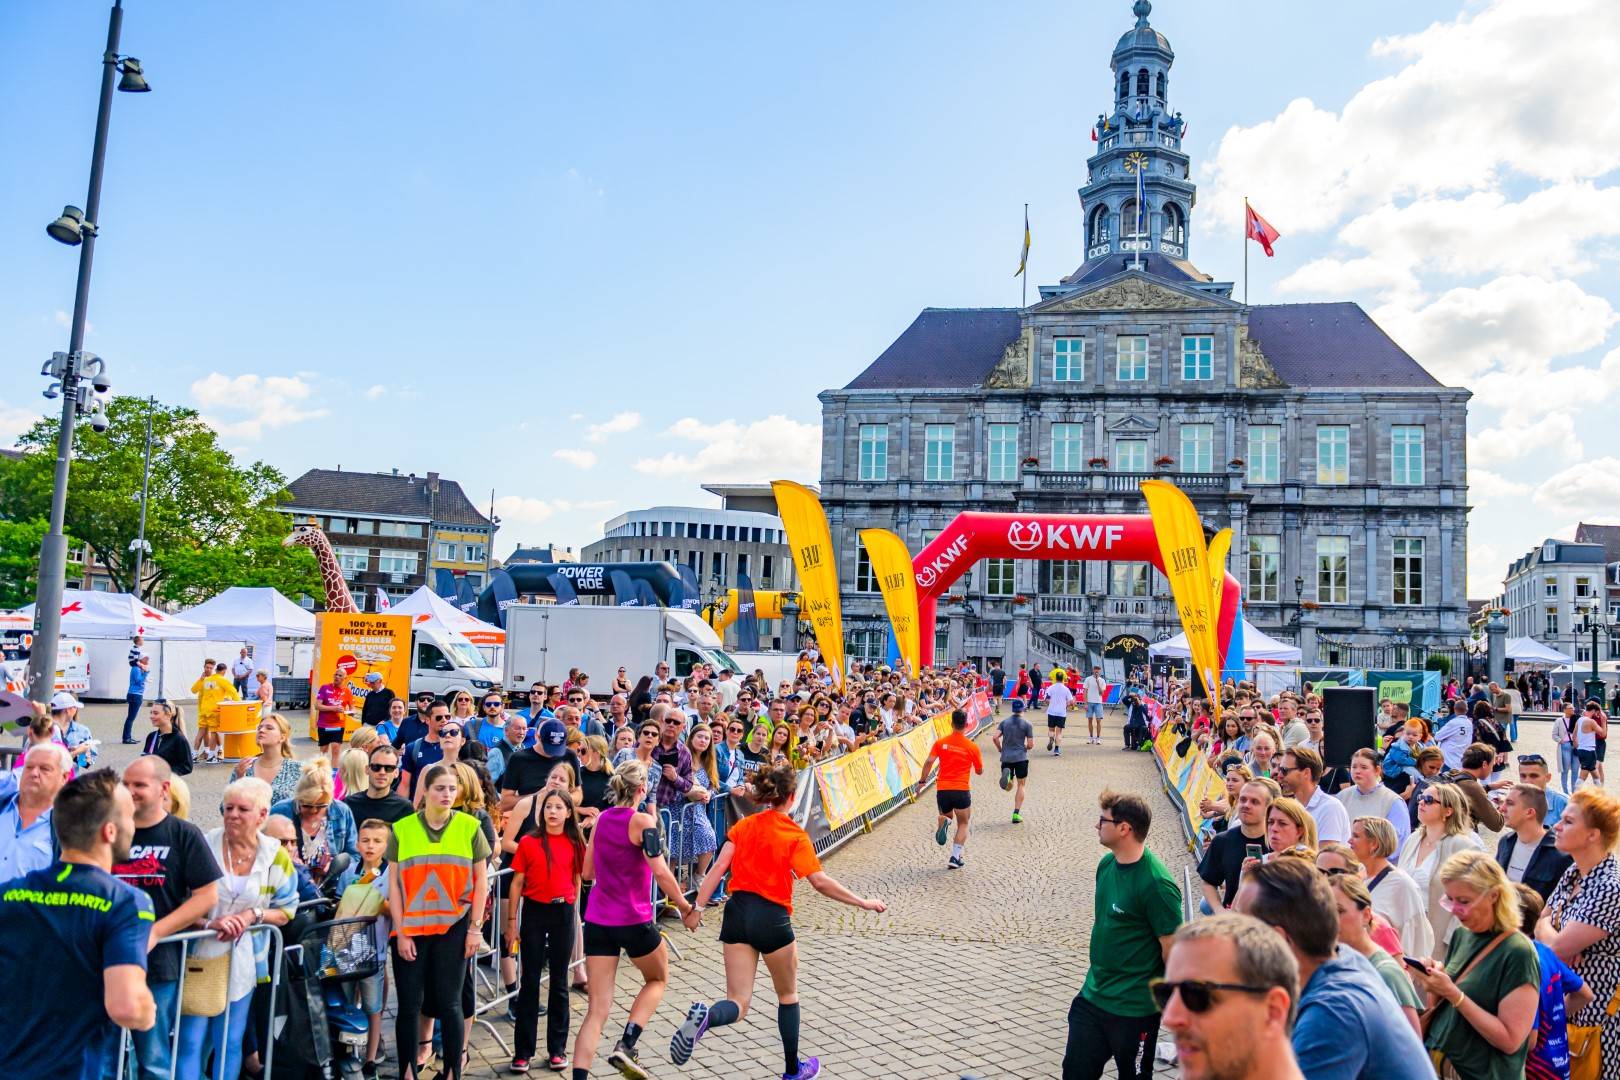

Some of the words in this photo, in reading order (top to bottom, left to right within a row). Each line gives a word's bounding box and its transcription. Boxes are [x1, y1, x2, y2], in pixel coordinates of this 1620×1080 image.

[1047, 525, 1124, 550] KWF
[933, 534, 968, 573] KWF
[557, 566, 605, 578] POWER
[577, 578, 604, 589] ADE
[350, 620, 374, 629] 100%
[376, 621, 388, 629] DE
[339, 628, 364, 636] ENIGE
[1459, 726, 1466, 736] 5
[129, 845, 171, 860] CATI
